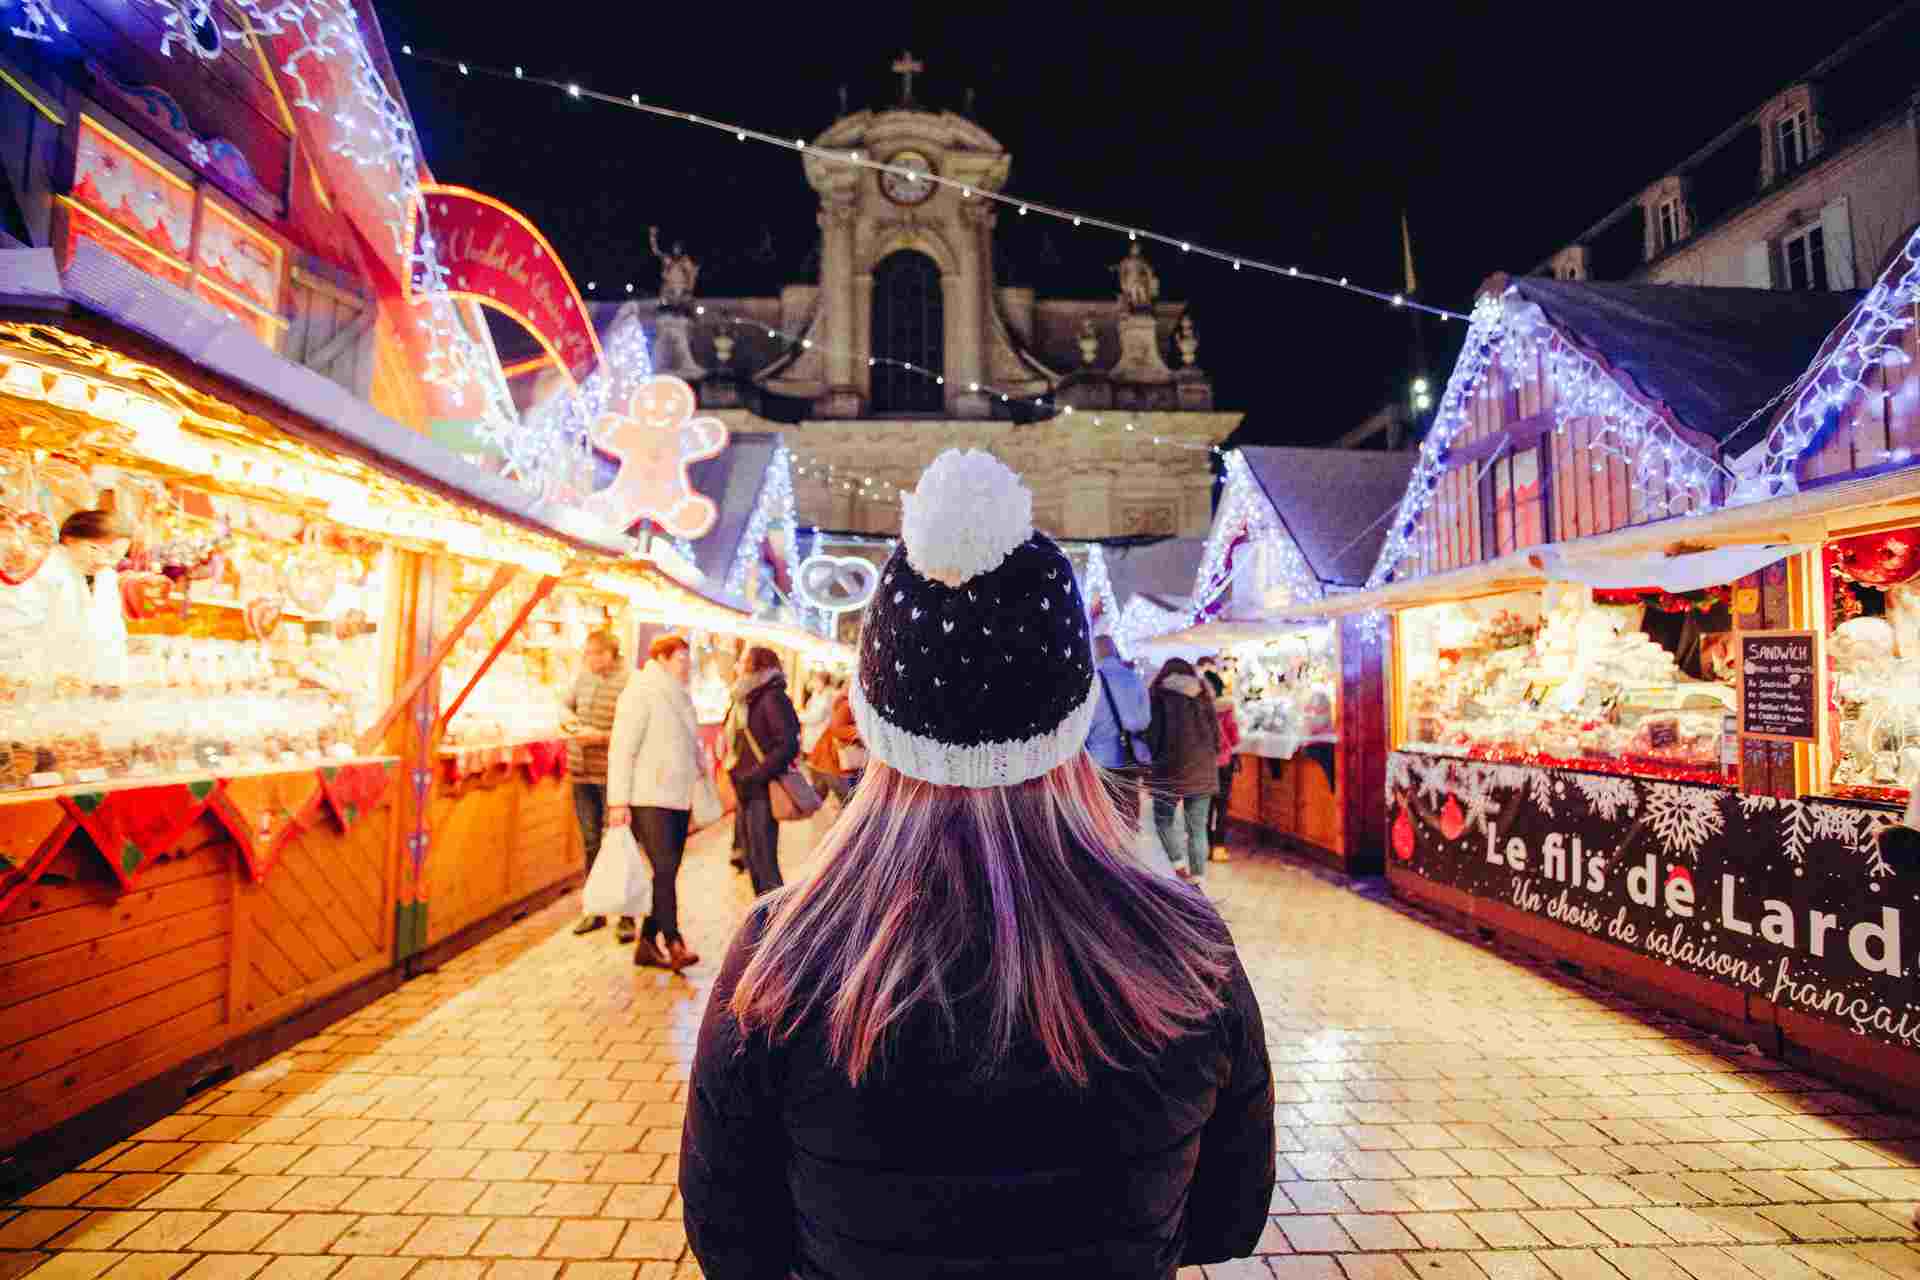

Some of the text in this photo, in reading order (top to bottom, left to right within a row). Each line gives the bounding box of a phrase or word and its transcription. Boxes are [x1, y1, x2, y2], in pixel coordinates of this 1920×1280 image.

[1486, 821, 1920, 978] Le fils de Lard
[1511, 876, 1544, 913] Un
[1547, 889, 1602, 932] choix
[1608, 905, 1639, 943] de
[1646, 922, 1765, 989] salaisons
